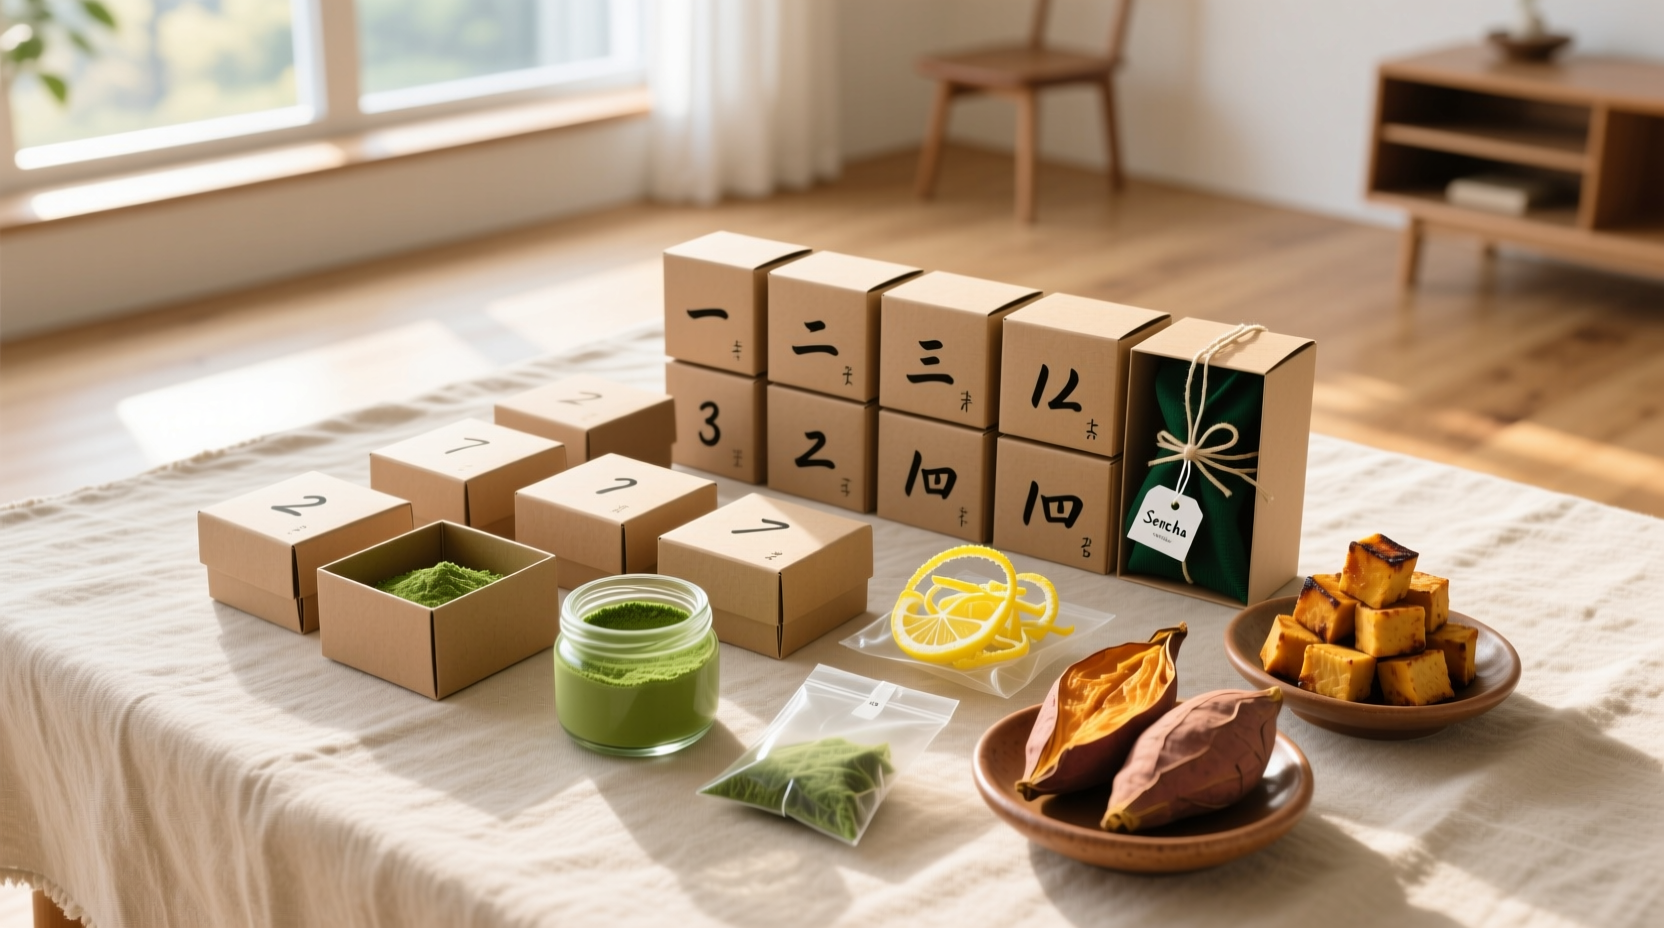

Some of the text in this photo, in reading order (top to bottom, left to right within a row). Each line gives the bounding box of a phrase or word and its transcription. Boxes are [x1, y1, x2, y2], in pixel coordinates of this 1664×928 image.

[791, 320, 839, 357] 二
[906, 339, 955, 386] 三
[698, 400, 722, 448] 3
[794, 430, 836, 470] 2
[270, 495, 327, 517] 2
[1142, 509, 1188, 539] Sencha
